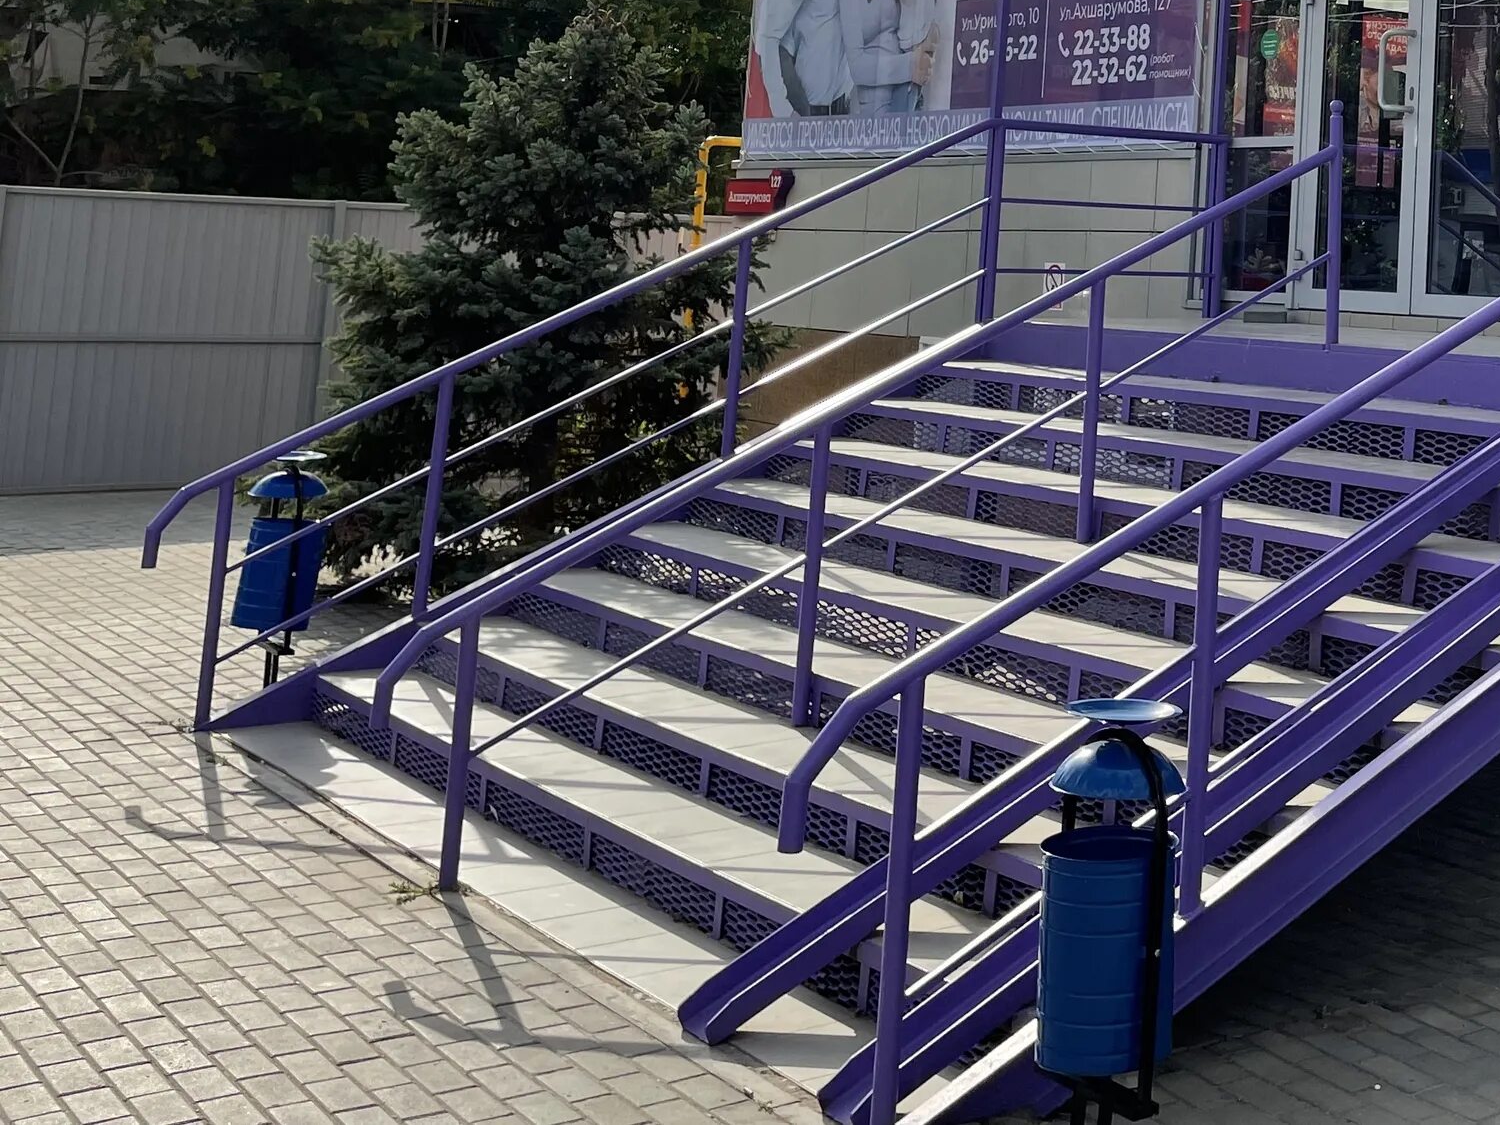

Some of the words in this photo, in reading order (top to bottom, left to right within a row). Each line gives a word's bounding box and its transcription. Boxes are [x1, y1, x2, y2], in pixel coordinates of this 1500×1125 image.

[1028, 6, 1040, 24] 10
[969, 35, 1038, 65] 26-6-22
[1073, 23, 1151, 56] 22-33-88
[1071, 54, 1148, 86] 22-32-62
[1150, 53, 1175, 66] (робот
[1091, 101, 1189, 137] СПЕЦИАЛИСТА
[770, 175, 782, 188] 127
